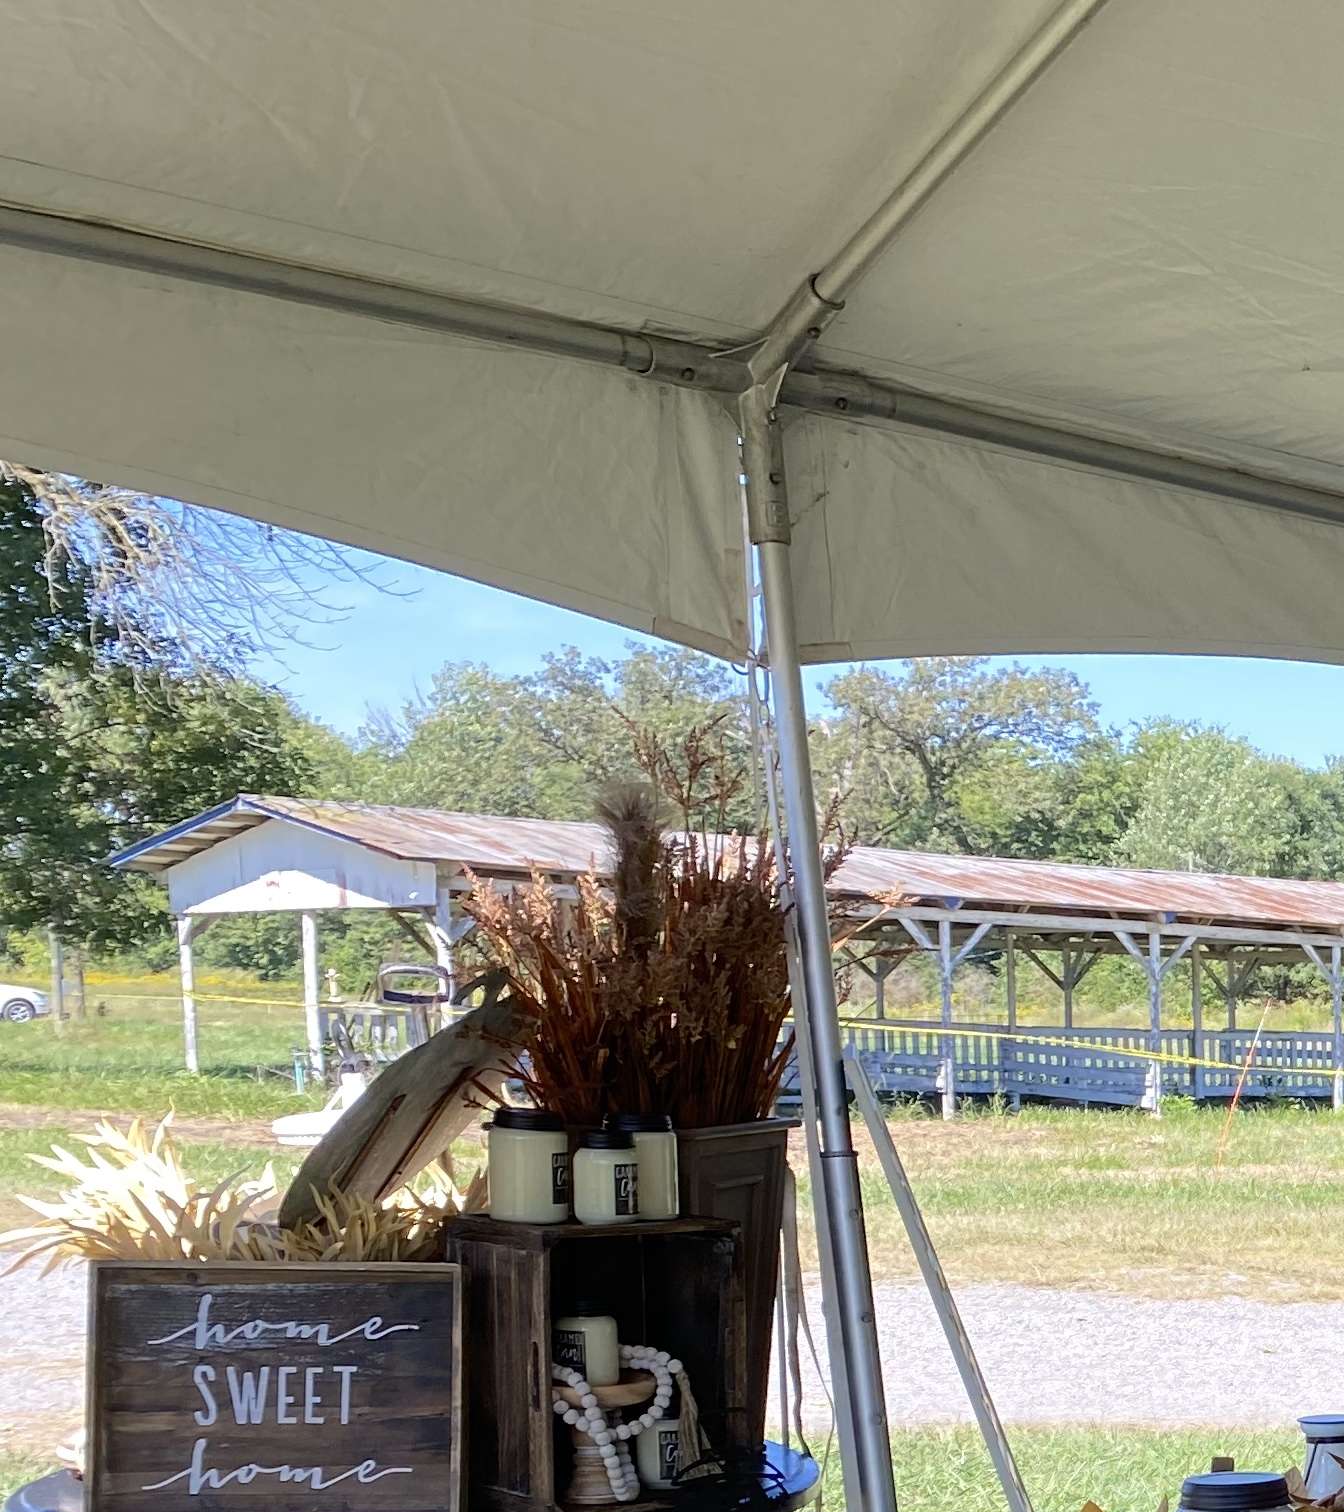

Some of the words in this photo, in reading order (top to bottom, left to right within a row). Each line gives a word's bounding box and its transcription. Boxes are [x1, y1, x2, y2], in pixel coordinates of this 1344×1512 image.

[147, 1294, 420, 1350] home
[193, 1365, 358, 1426] SWEET
[141, 1438, 413, 1496] home
